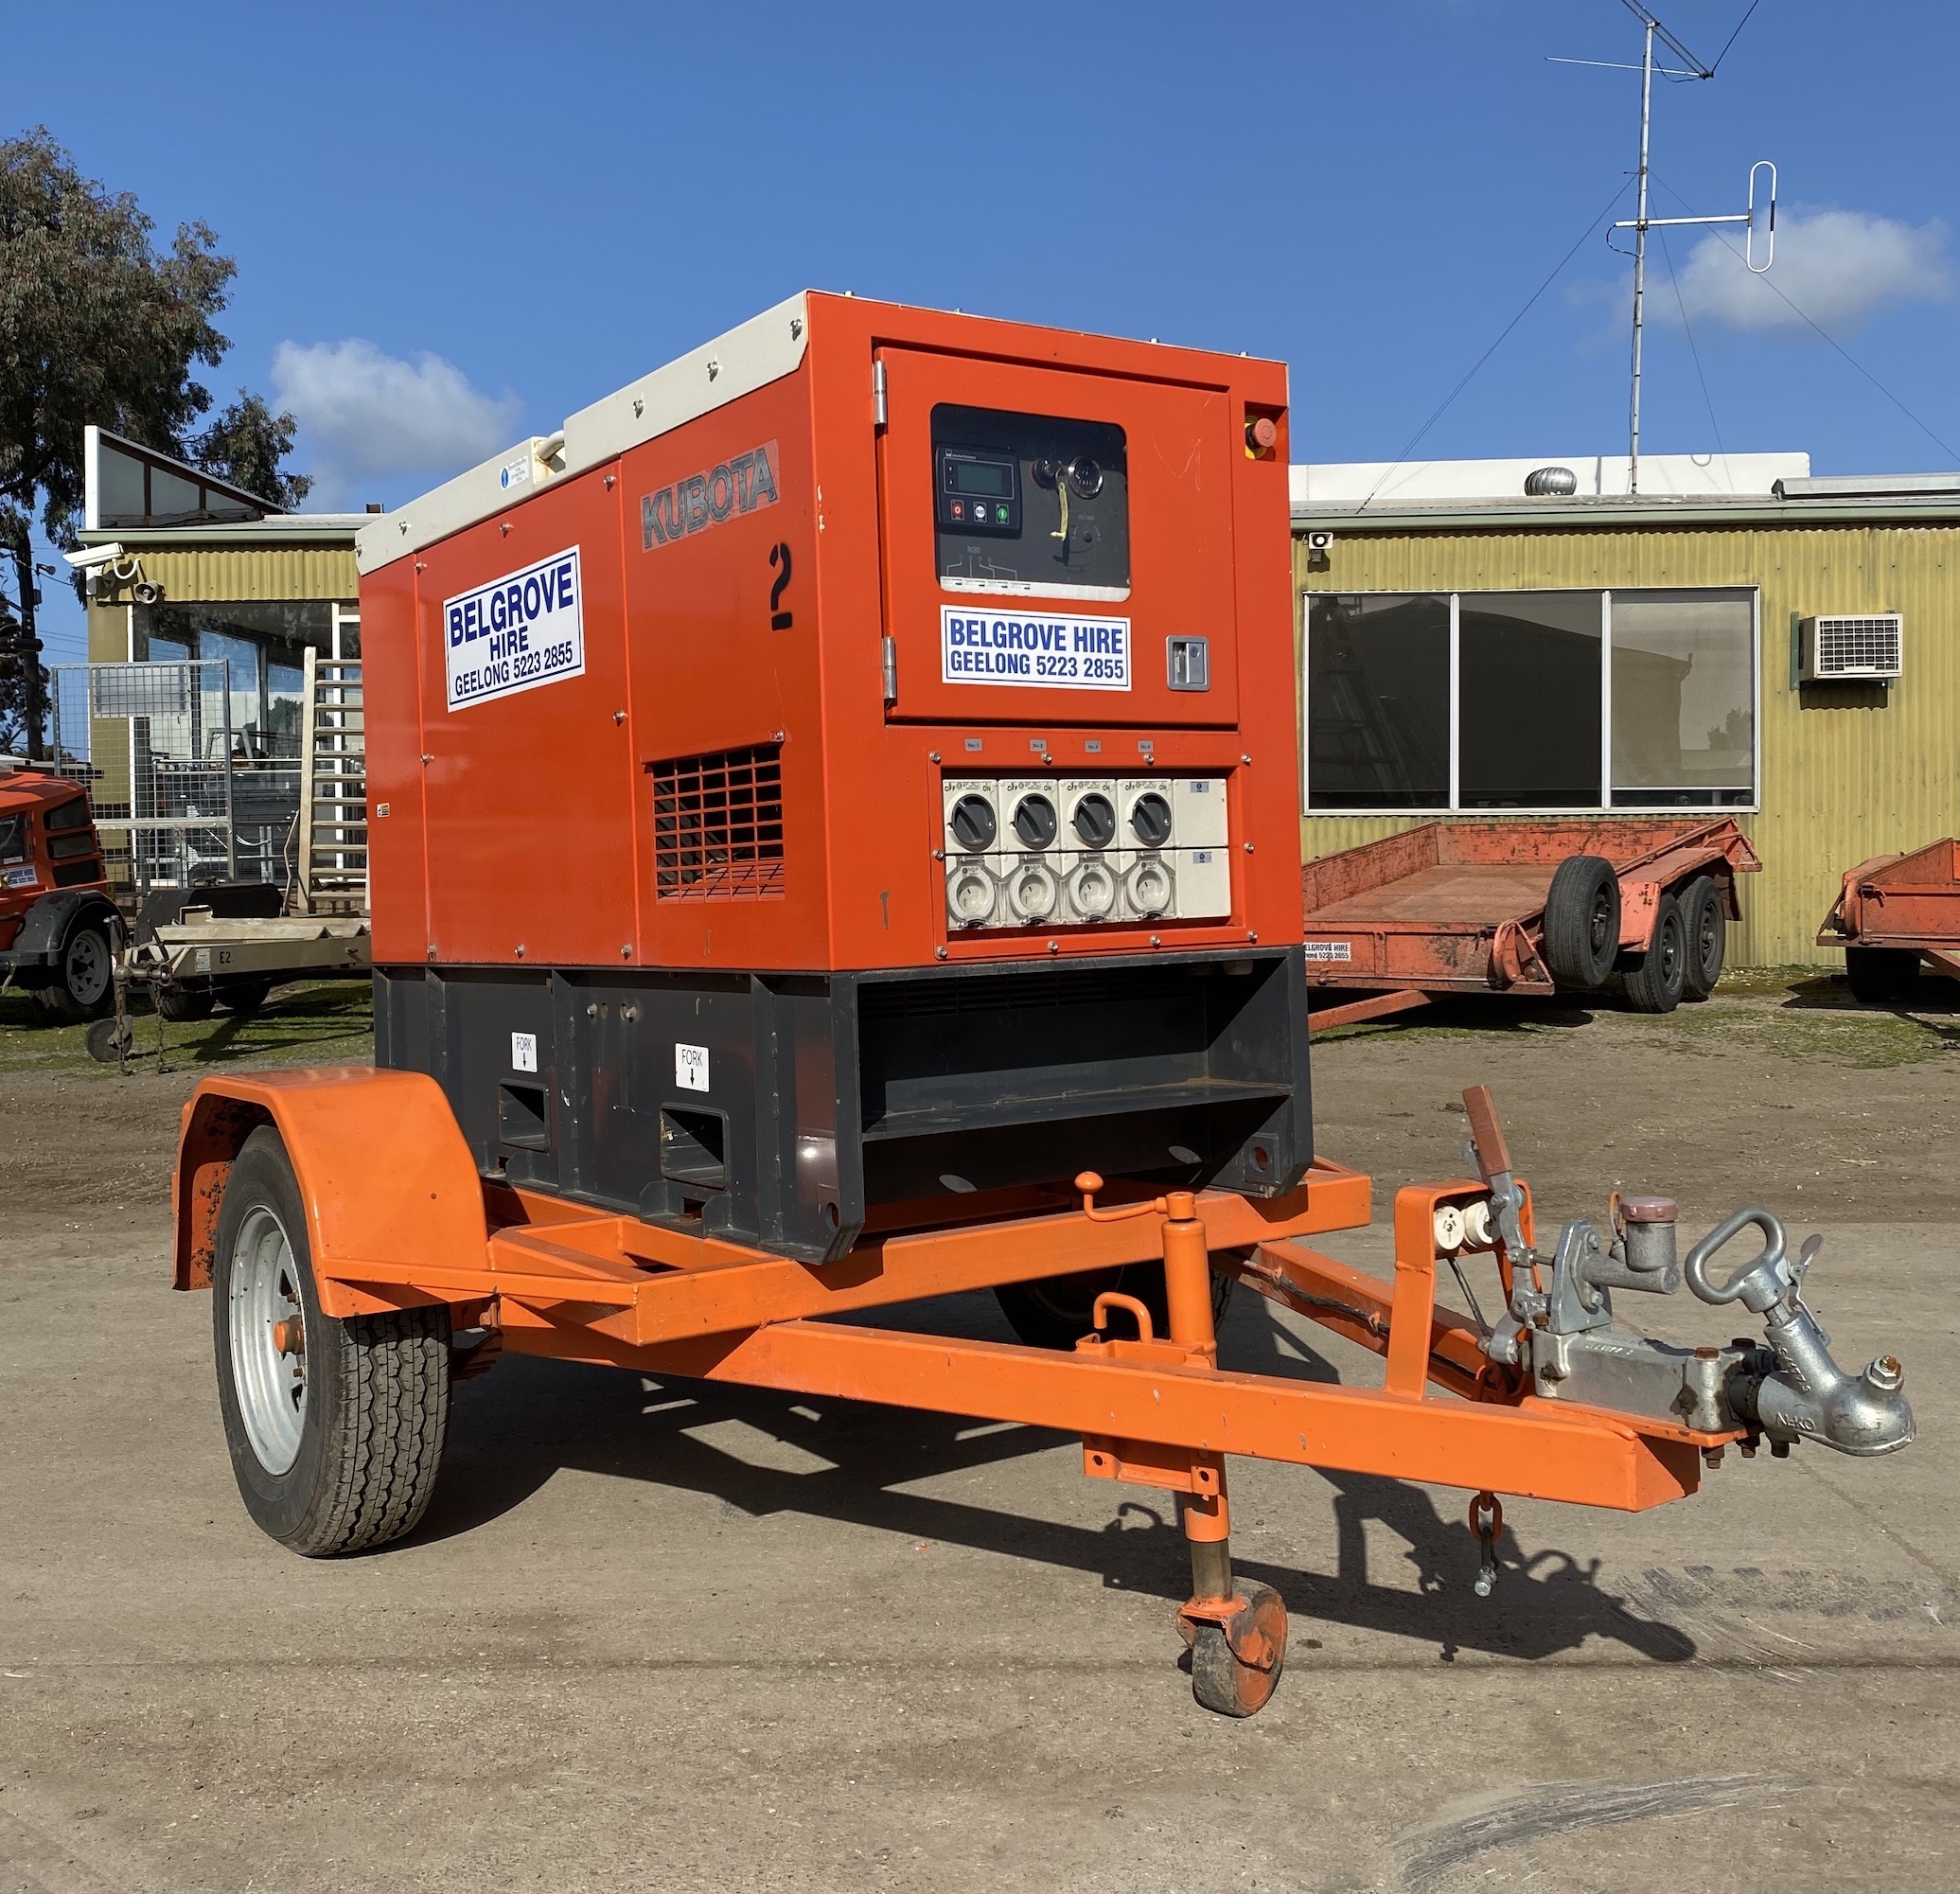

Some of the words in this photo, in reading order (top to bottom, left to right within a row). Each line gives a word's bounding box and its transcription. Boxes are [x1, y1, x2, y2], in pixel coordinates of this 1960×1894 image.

[642, 448, 778, 548] KUBOTA
[450, 561, 574, 648] BELGROVE
[489, 625, 529, 662] HIRE
[950, 618, 1067, 651] BELGROVE
[1073, 626, 1123, 654] HIRE
[455, 660, 509, 697] GEELONG
[513, 651, 541, 679] 5223
[543, 640, 573, 669] 2855
[950, 650, 1031, 675] GEELONG
[1036, 655, 1078, 677] 5223
[1083, 657, 1124, 679] 2855
[220, 951, 231, 964] E2
[516, 1036, 532, 1052] FORK
[681, 1049, 703, 1068] FORK
